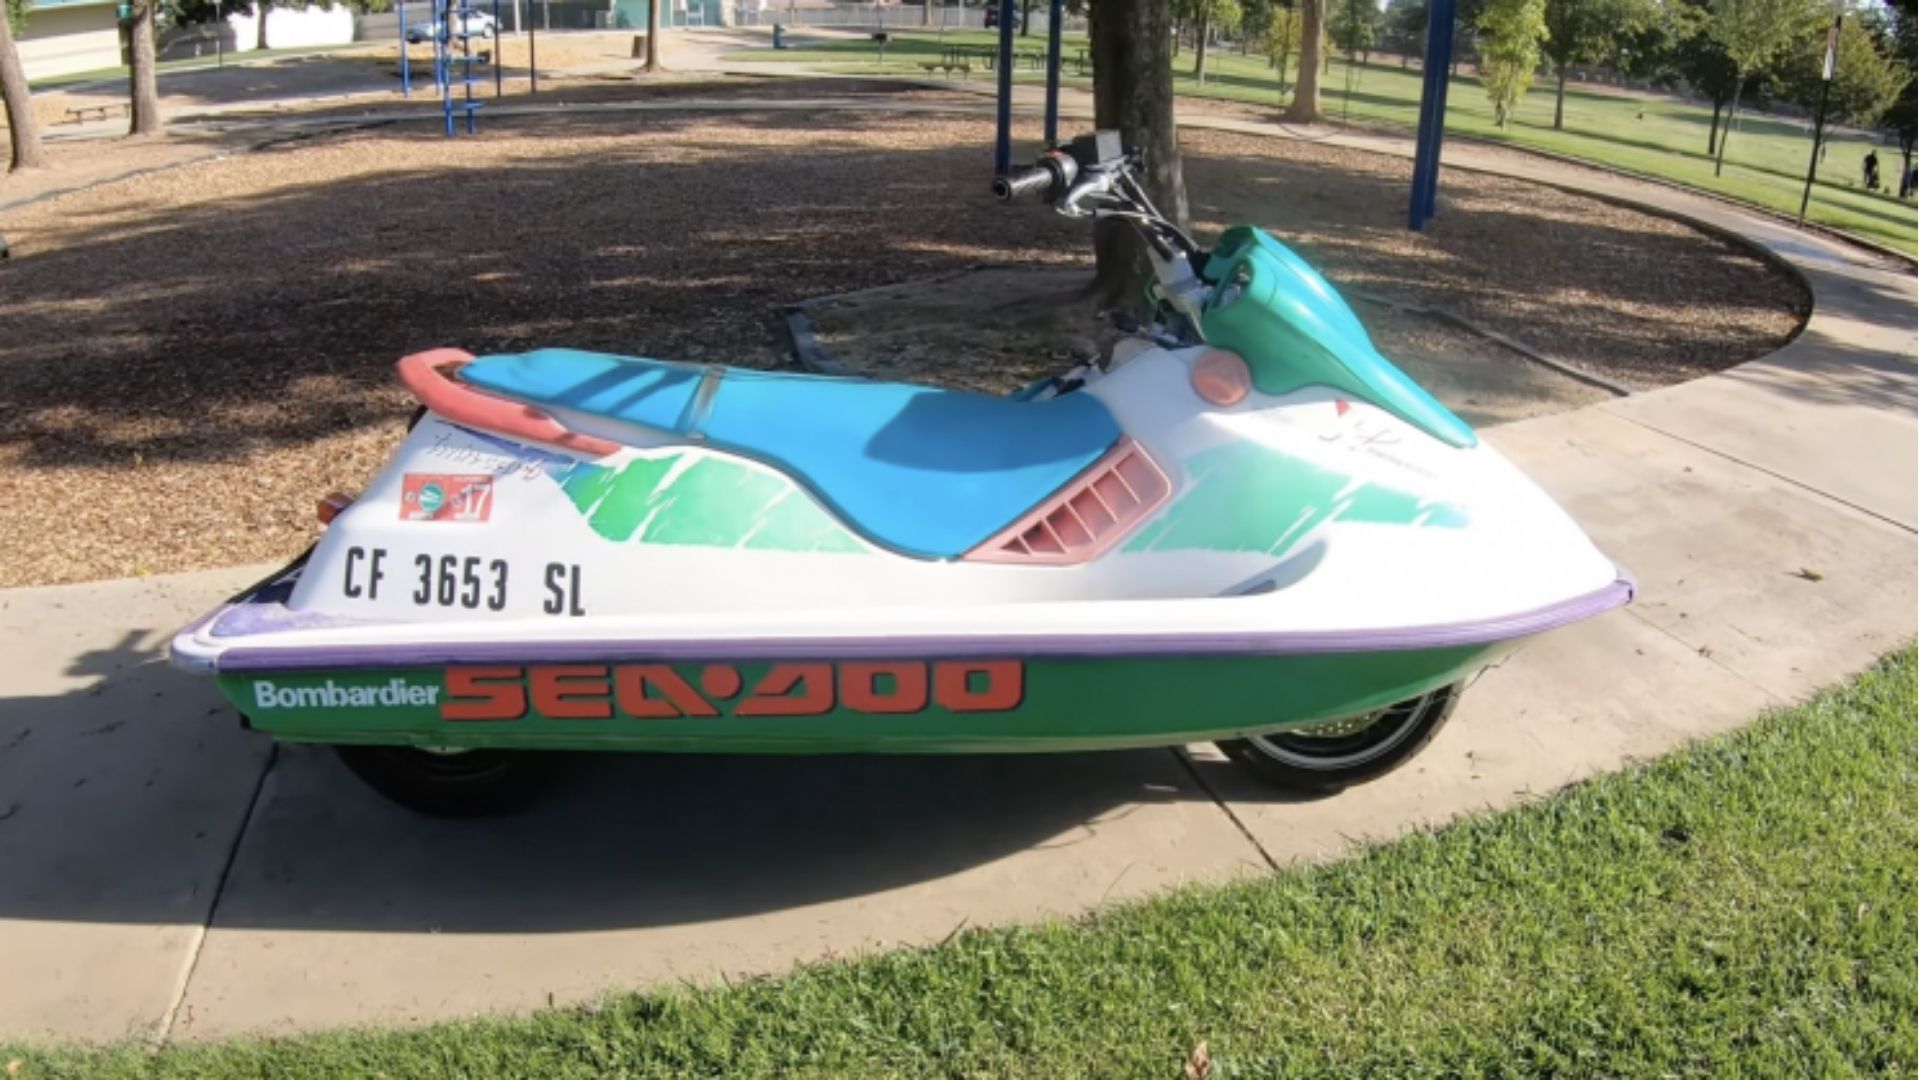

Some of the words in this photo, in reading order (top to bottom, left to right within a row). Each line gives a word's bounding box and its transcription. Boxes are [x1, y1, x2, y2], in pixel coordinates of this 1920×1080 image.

[461, 483, 491, 519] 17
[343, 546, 388, 600] CF
[413, 553, 509, 612] 3653
[542, 562, 586, 617] SL
[253, 679, 440, 708] Bombardier
